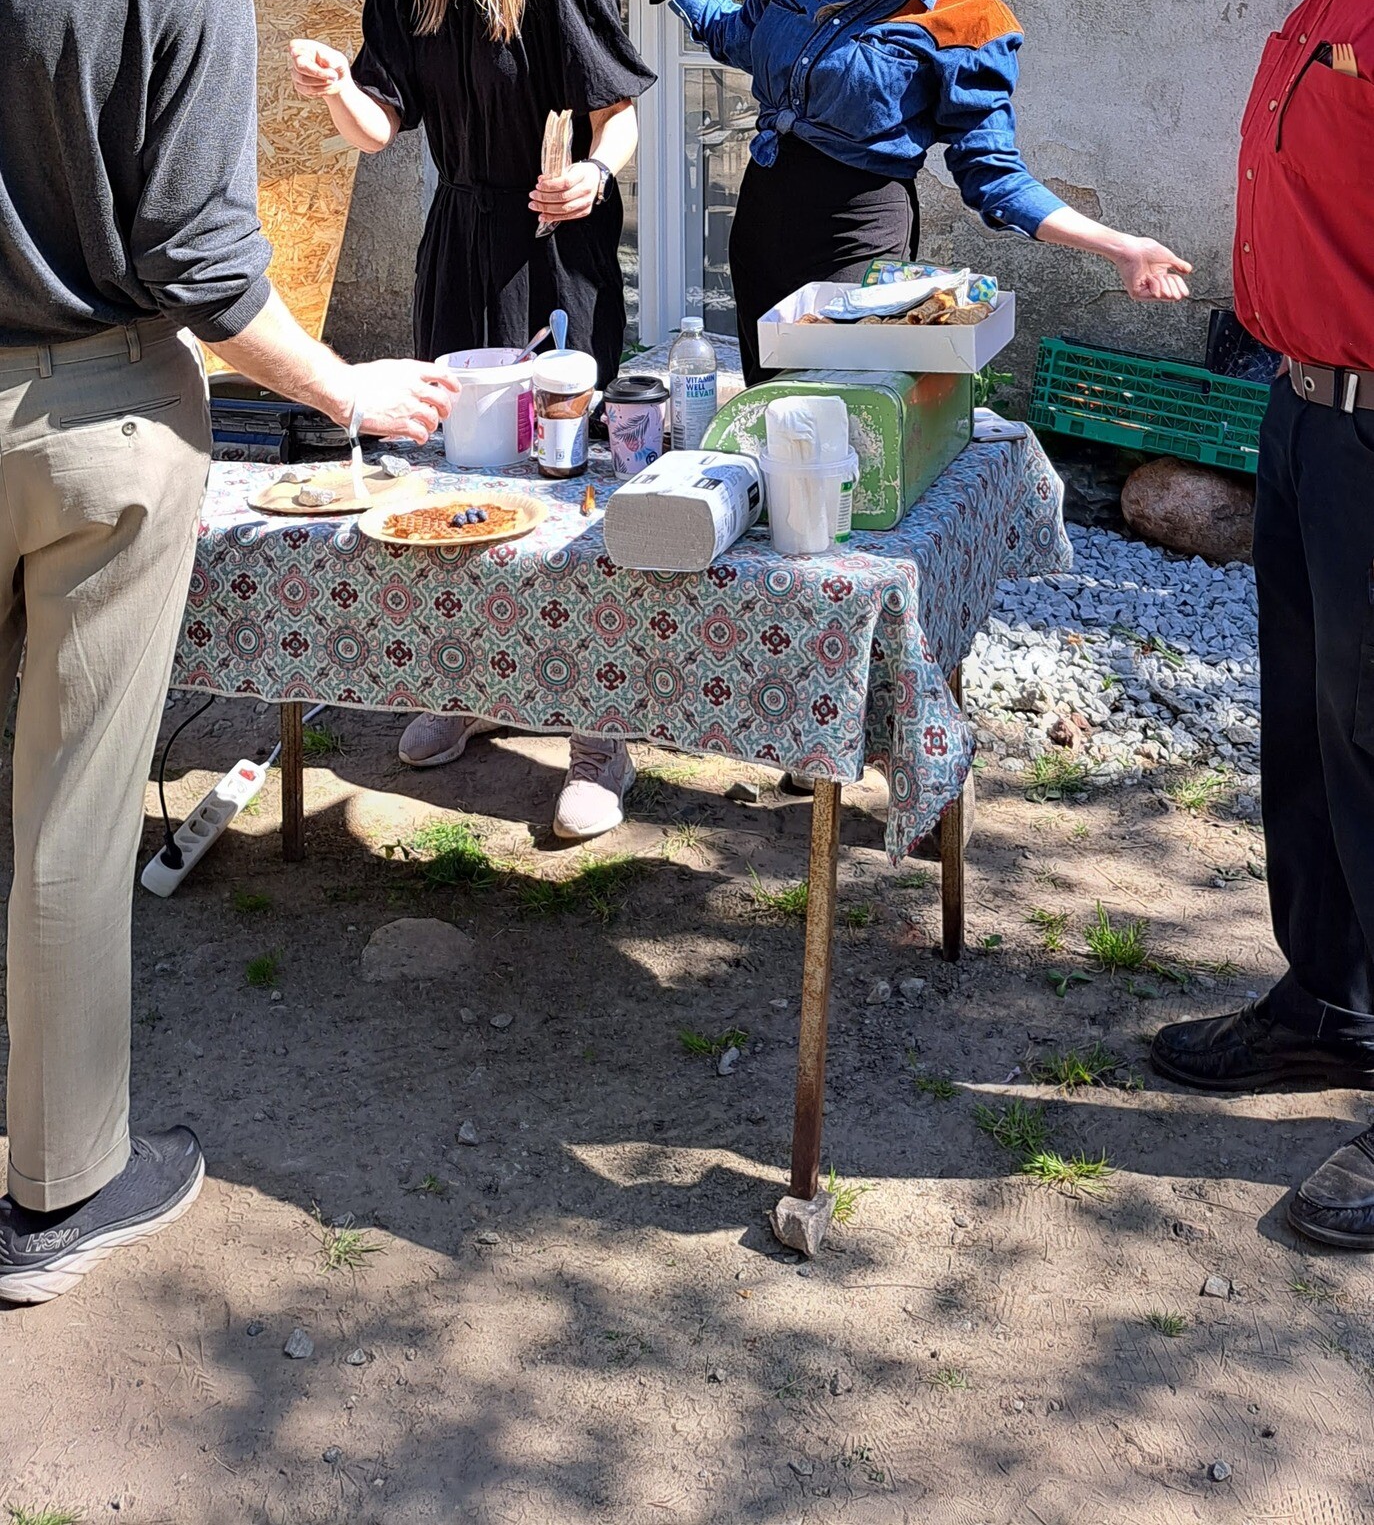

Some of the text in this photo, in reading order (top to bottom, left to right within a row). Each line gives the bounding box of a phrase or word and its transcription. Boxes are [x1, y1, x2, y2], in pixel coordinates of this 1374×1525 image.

[685, 374, 715, 384] VITAMIN
[685, 383, 706, 391] WELL
[686, 388, 715, 398] ELEVATE
[25, 1228, 80, 1253] HOKA
